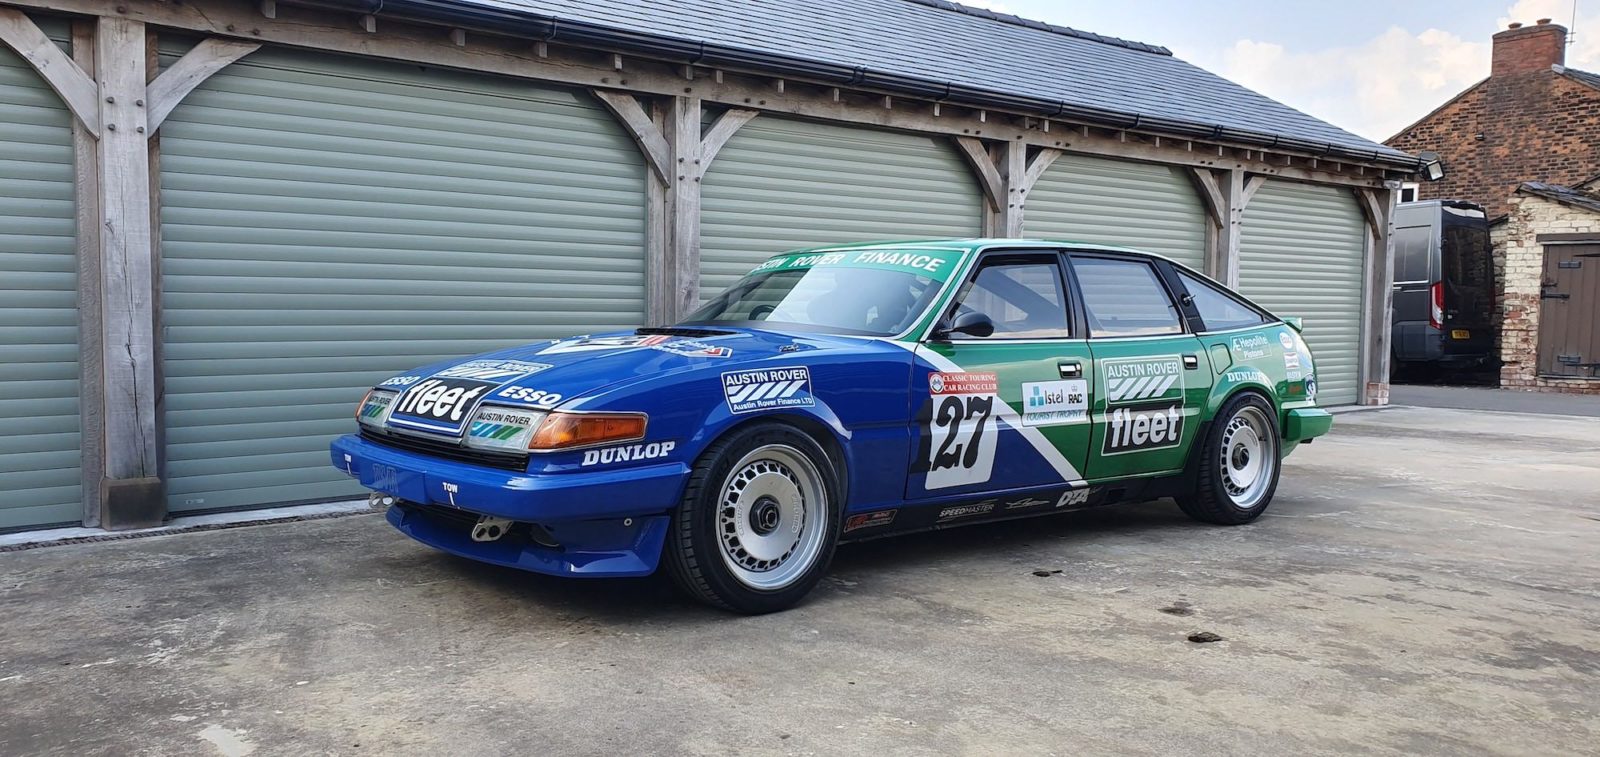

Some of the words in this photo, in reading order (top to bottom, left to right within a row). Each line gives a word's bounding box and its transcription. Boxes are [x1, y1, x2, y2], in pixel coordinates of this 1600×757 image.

[788, 253, 847, 268] ROVER
[853, 252, 946, 272] FINANCE
[726, 371, 768, 386] AUSTIN
[770, 369, 808, 382] ROVER
[1107, 364, 1145, 378] AUSTIN
[1147, 362, 1179, 375] ROVER
[398, 379, 488, 421] fleet
[498, 385, 562, 404] ESSO
[1068, 393, 1083, 404] RAC
[733, 401, 757, 411] Austin
[758, 399, 777, 409] Rover
[777, 398, 801, 406] Finance
[476, 412, 505, 422] AUSTIN
[504, 413, 531, 426] ROVER
[1111, 404, 1180, 448] fleet
[910, 395, 993, 474] 127
[581, 441, 676, 466] DUNLOP
[442, 482, 458, 493] TOW
[938, 503, 996, 518] SPEEDMASTER
